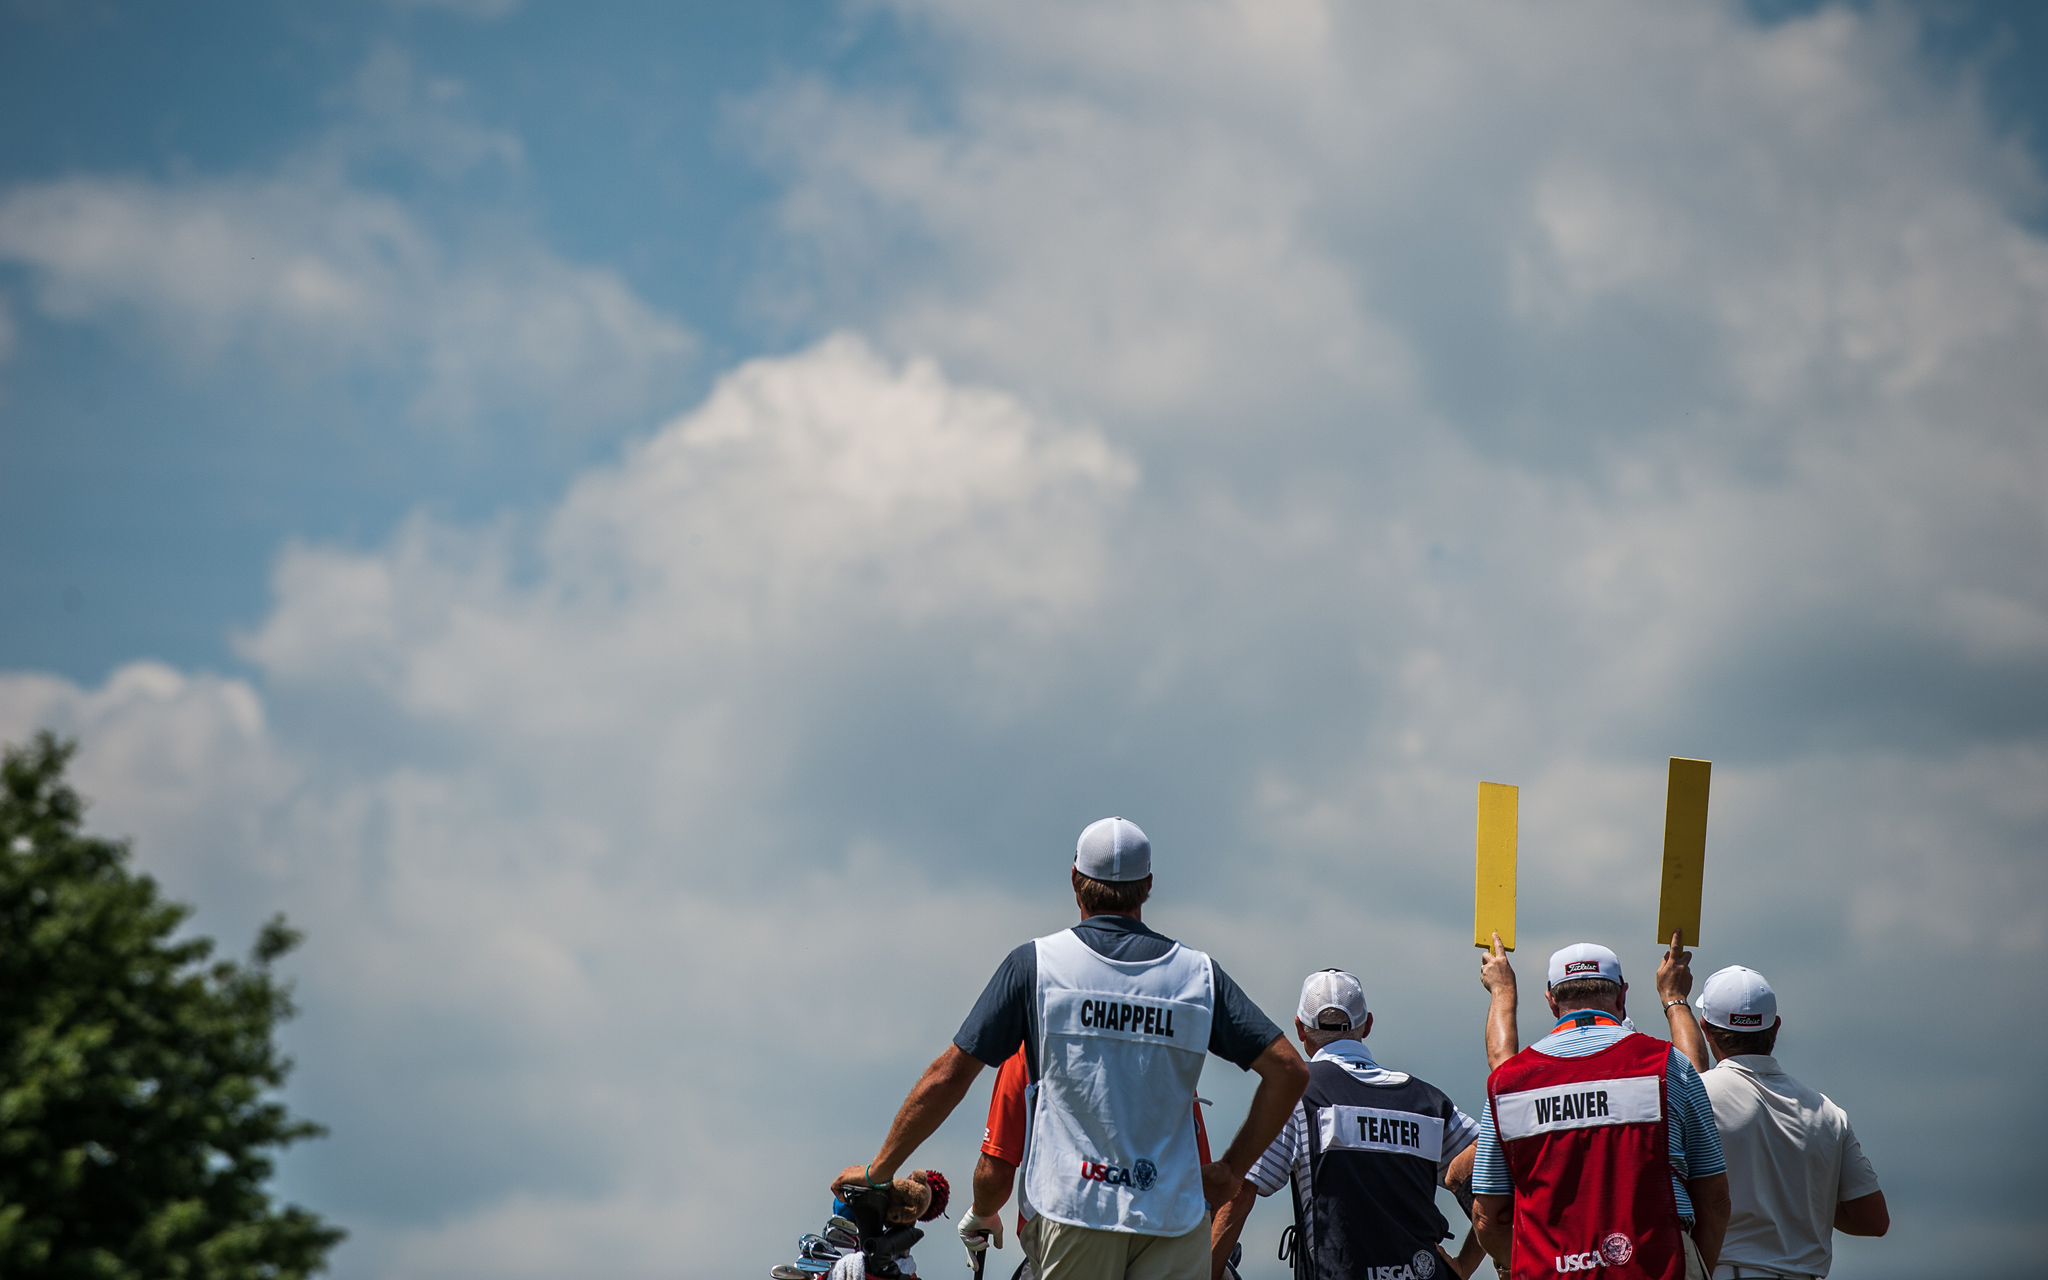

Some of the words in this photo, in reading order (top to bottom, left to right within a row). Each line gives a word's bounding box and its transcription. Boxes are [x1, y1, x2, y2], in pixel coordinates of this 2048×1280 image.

[1081, 1000, 1174, 1038] CHAPPELL
[1732, 1016, 1760, 1025] Titleist
[1535, 1091, 1609, 1125] WEAVER
[1357, 1116, 1419, 1149] TEATER
[1081, 1161, 1132, 1187] USGA
[1367, 1264, 1416, 1280] USGA
[1555, 1250, 1606, 1273] USGA
